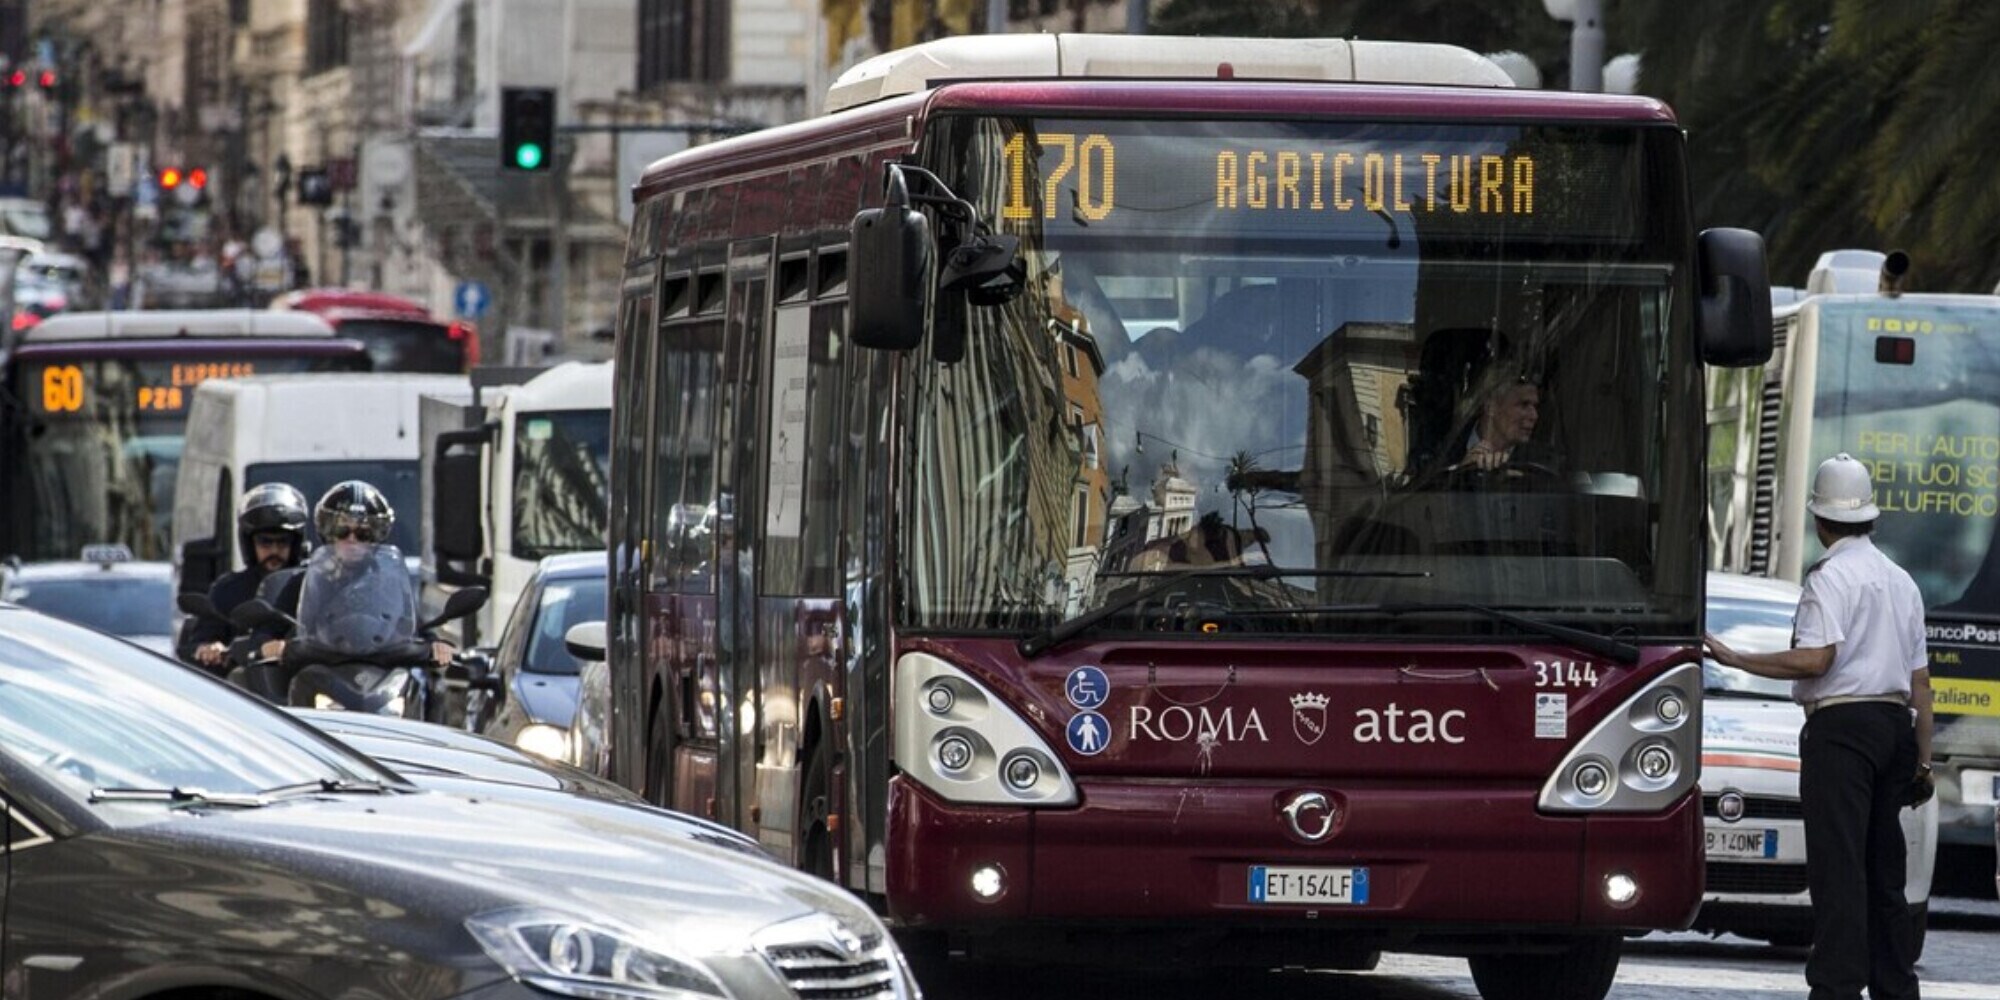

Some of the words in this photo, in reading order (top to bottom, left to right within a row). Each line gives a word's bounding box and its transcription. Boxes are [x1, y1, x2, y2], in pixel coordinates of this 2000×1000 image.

[1002, 133, 1115, 220] 170
[1216, 150, 1534, 213] AGRICOLTURA
[42, 364, 84, 413] 60
[1859, 431, 1907, 454] PER
[1904, 461, 1959, 486] TUOI
[1872, 489, 1998, 517] LL'UFFICIO
[1926, 624, 2000, 642] ancoPost
[1533, 660, 1599, 688] 3144
[1931, 687, 1991, 707] taliane
[1129, 705, 1269, 742] ROMA
[1353, 702, 1467, 744] atac
